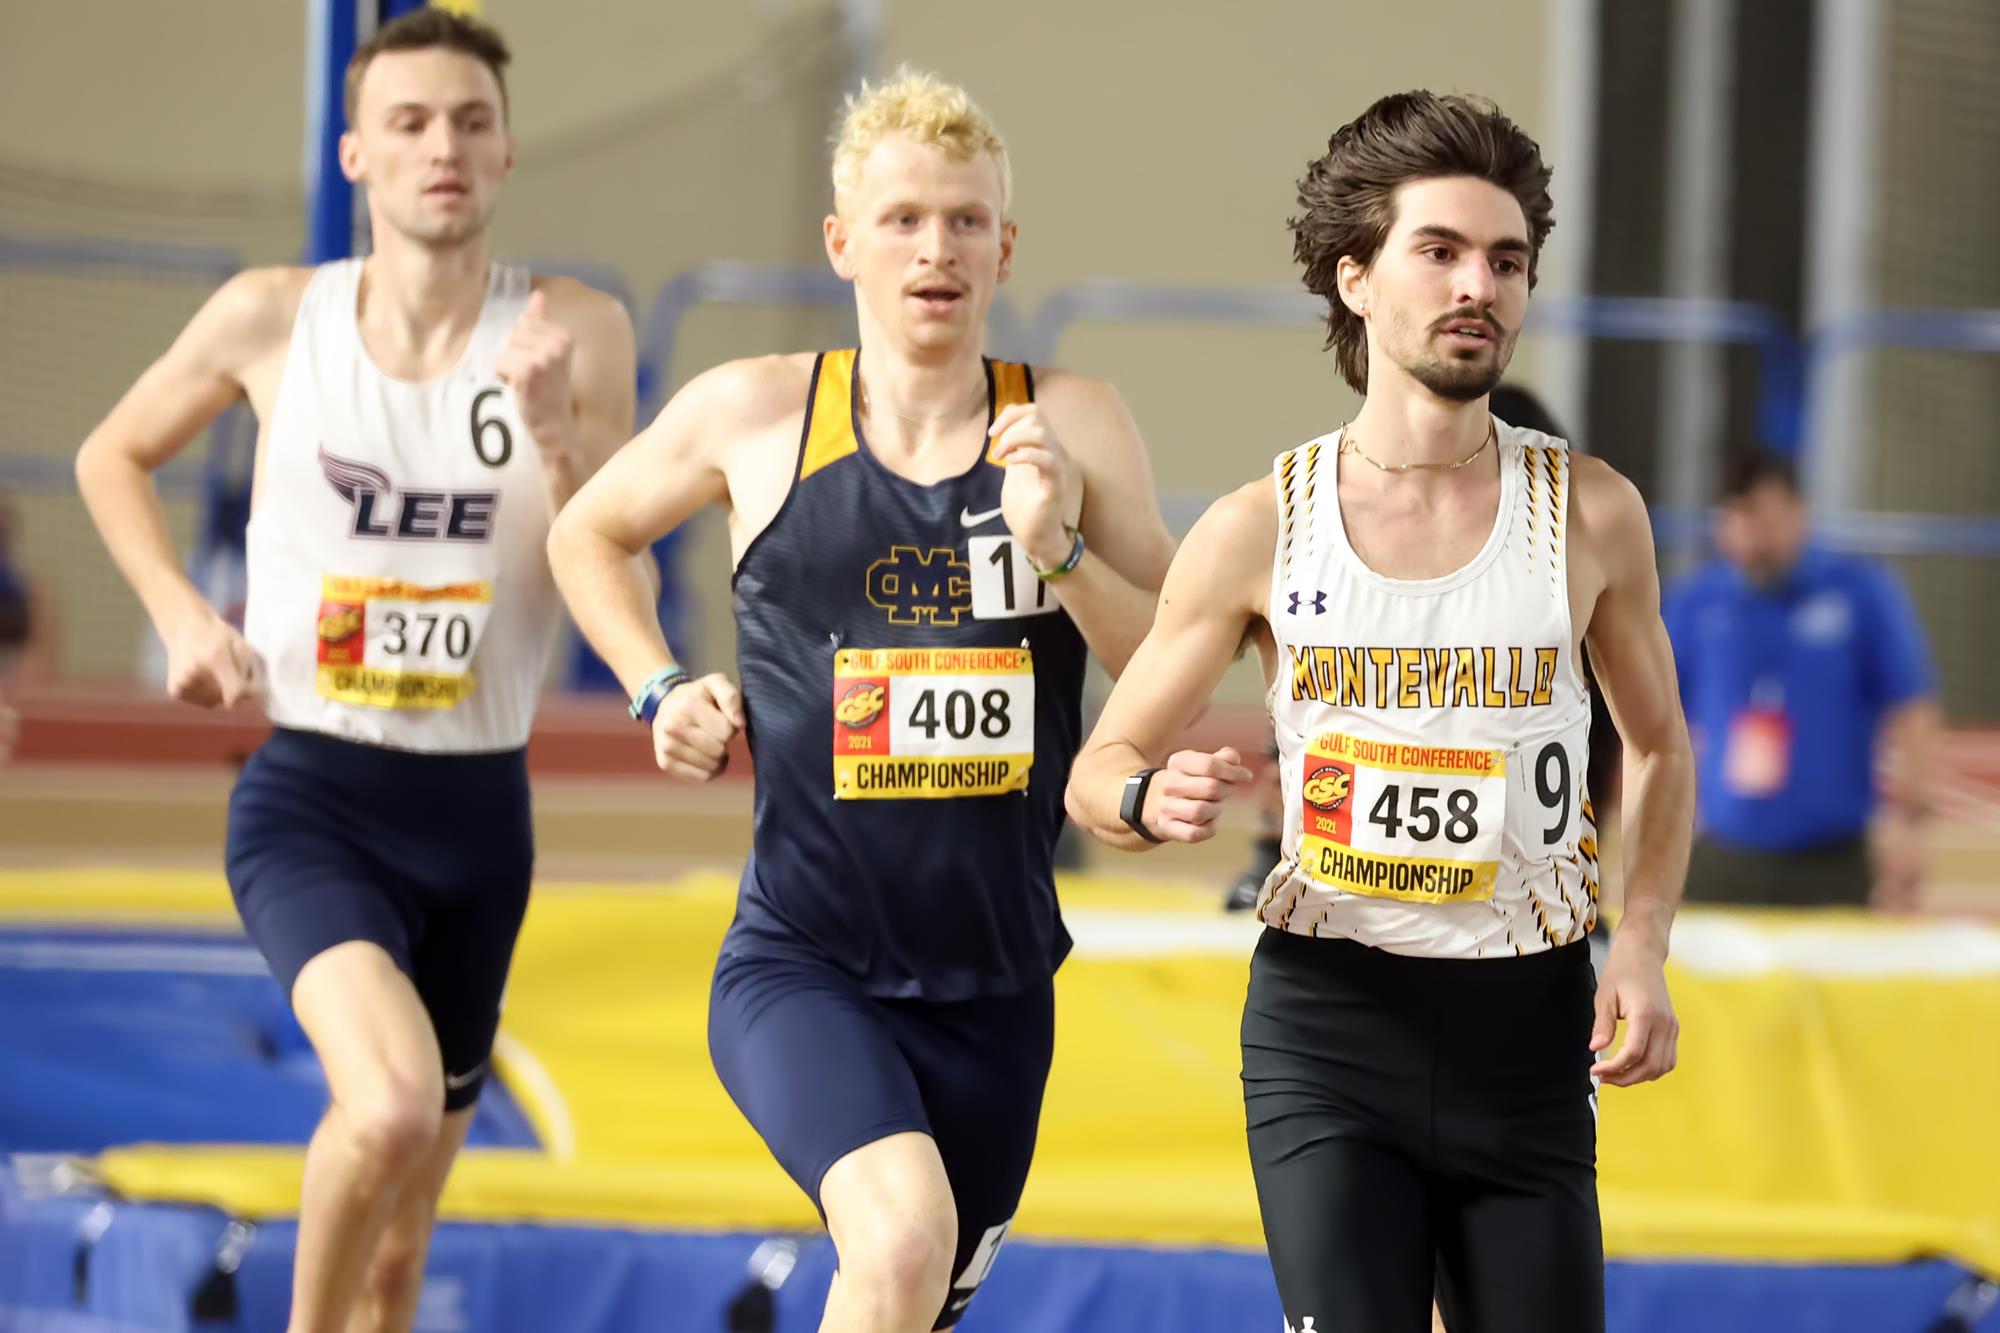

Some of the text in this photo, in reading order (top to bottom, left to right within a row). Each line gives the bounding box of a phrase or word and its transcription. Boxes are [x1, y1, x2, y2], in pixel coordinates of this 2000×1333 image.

[470, 388, 513, 468] 6
[350, 486, 501, 542] LEE
[383, 611, 471, 659] 370
[850, 651, 1020, 670] GULF SOUTH CONFERENCE
[1288, 645, 1558, 709] MONTEVALLO
[909, 688, 1011, 740] 408
[848, 735, 872, 750] 2021
[1320, 732, 1491, 770] GULF SOUTH CONFERENCE
[857, 761, 1010, 790] CHAMPIONSHIP
[1303, 774, 1351, 804] GSC
[1535, 742, 1571, 845] 9
[1316, 816, 1337, 835] 2021
[1368, 783, 1479, 844] 458
[1320, 847, 1474, 894] CHAMPIONSHIP
